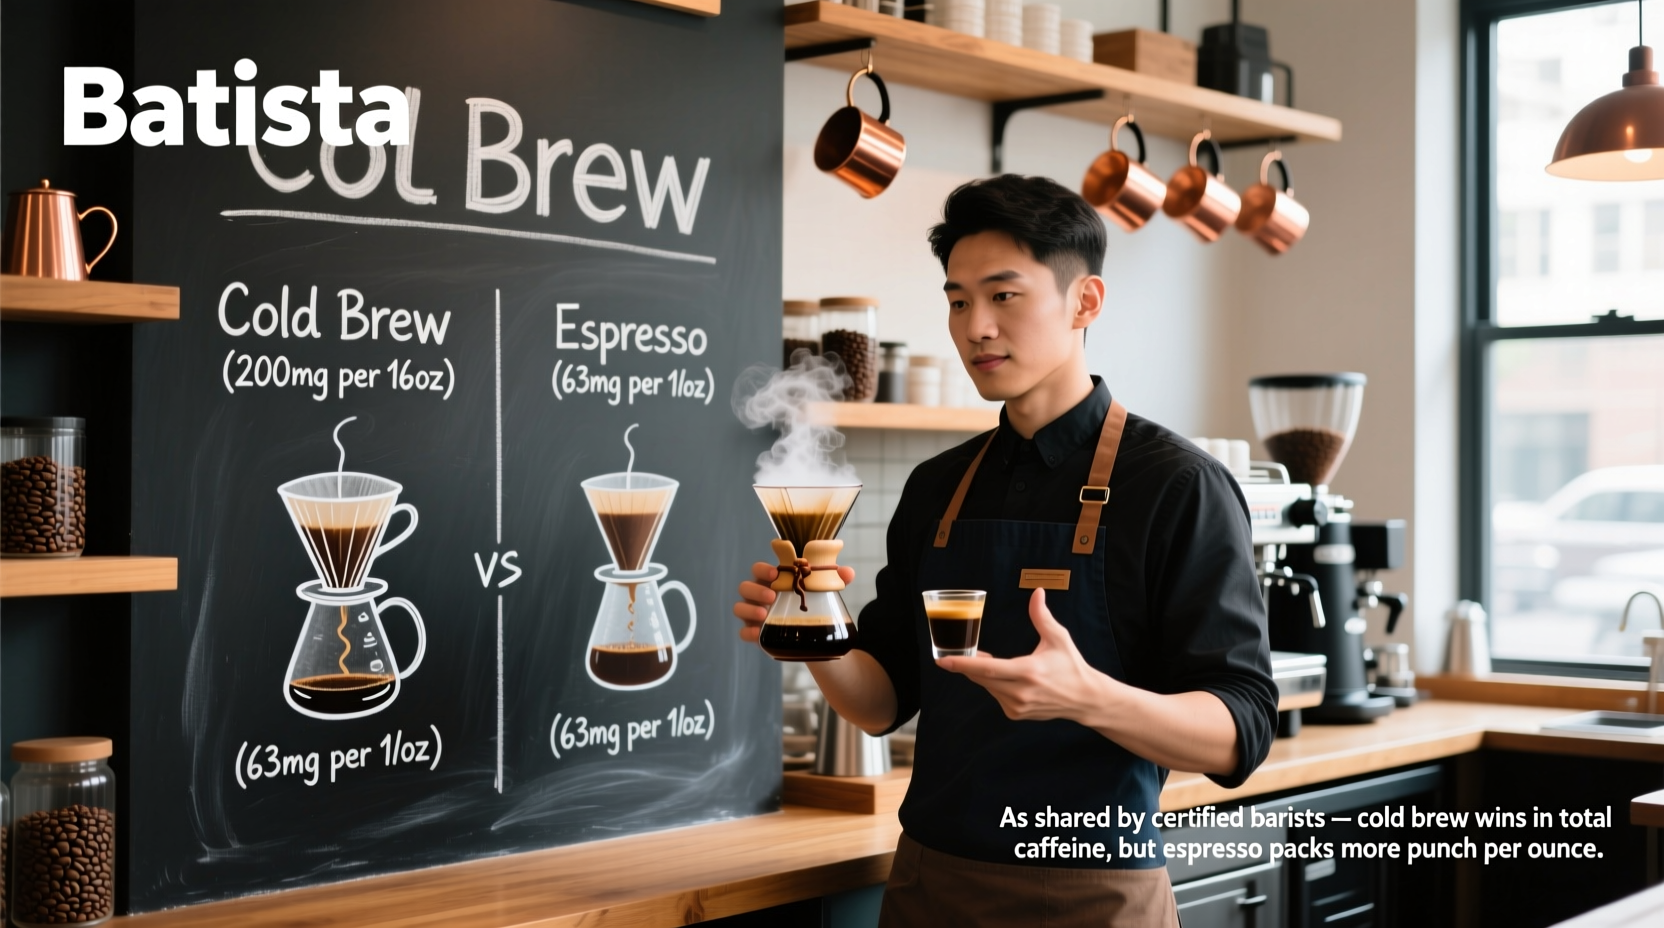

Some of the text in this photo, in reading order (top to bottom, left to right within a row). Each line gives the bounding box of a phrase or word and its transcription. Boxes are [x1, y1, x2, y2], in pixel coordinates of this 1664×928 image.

[465, 97, 712, 236] Brew
[217, 281, 452, 346] Cold Brew
[555, 302, 708, 366] Espresso
[222, 349, 456, 402] (200mg per 16oz)
[551, 359, 621, 406] (63mg
[628, 375, 664, 405] per
[235, 724, 443, 790] (63mg per 1/oz)
[550, 698, 715, 760] (63mg per 1/oz)
